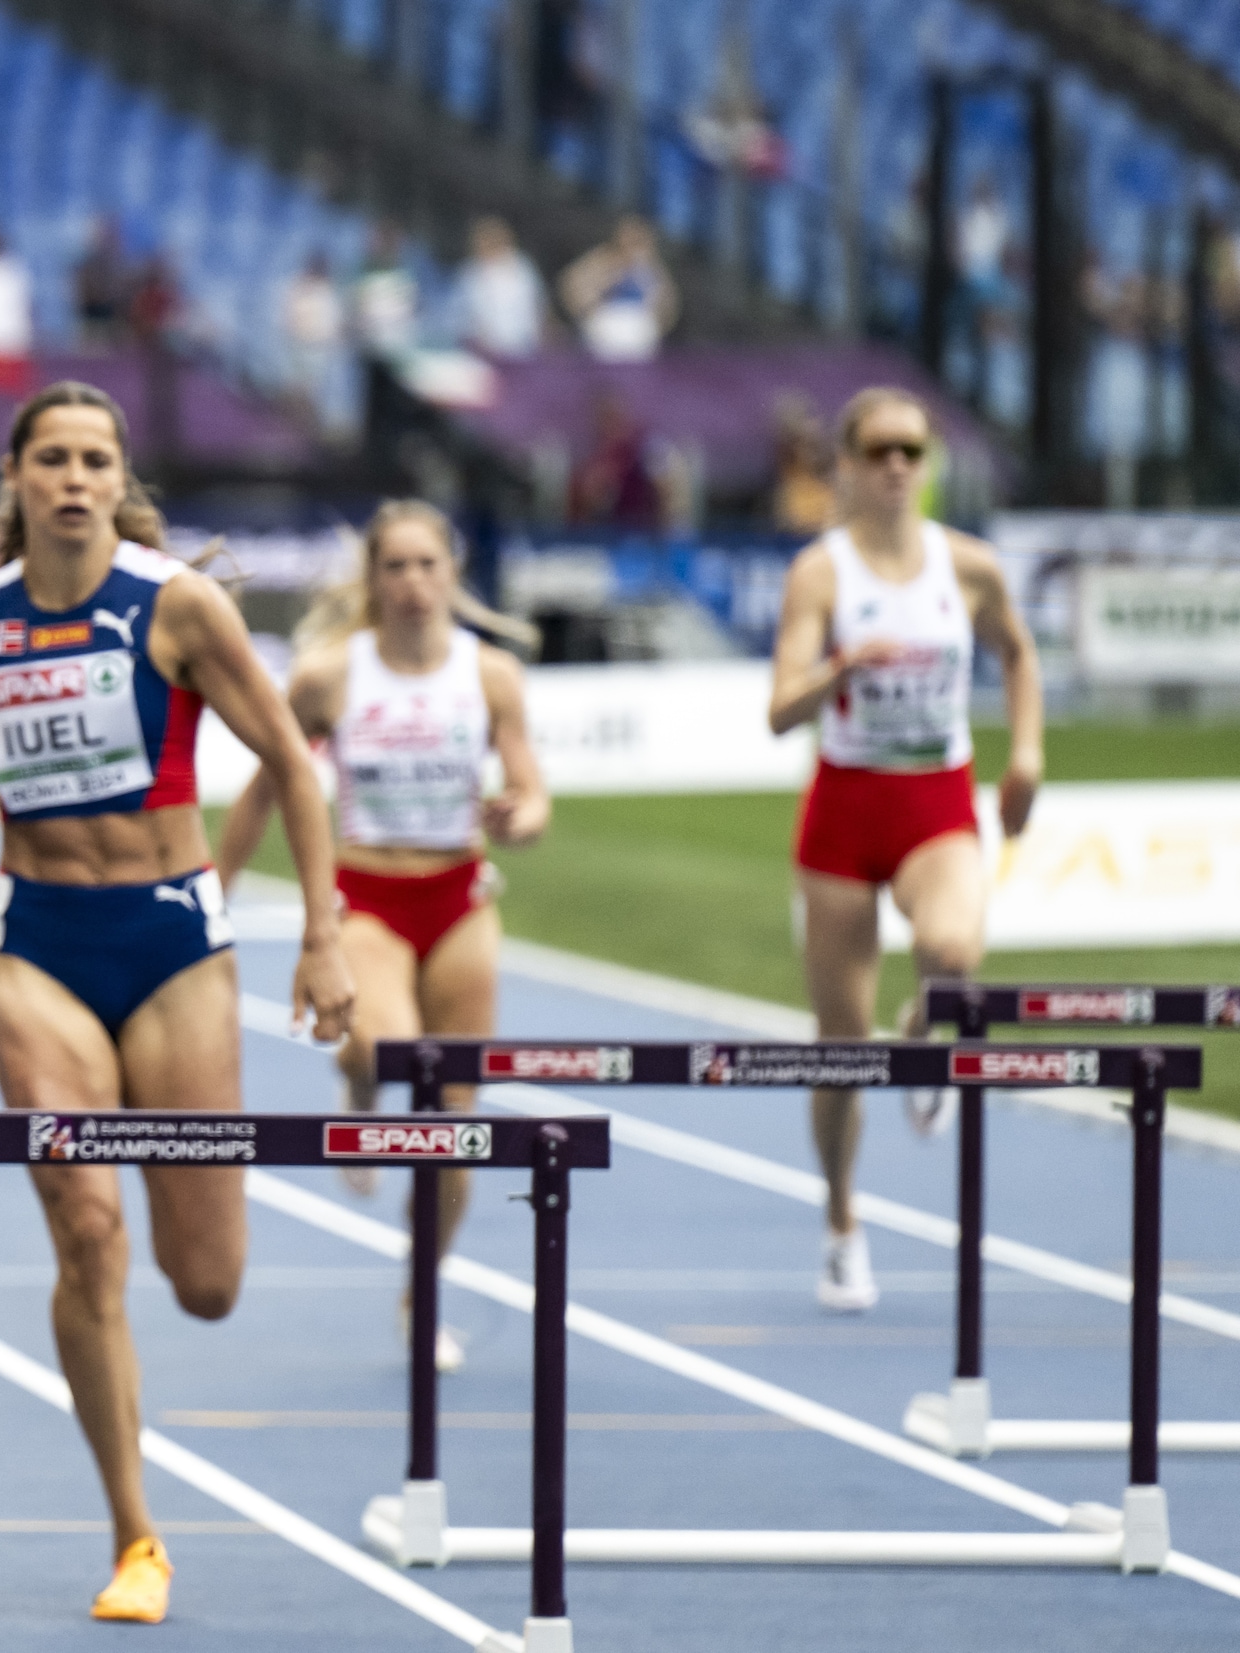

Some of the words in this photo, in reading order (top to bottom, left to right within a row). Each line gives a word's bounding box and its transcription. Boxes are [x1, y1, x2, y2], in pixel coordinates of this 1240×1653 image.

[3, 712, 106, 758] IUEL
[980, 1055, 1066, 1080] SPAR
[78, 1140, 257, 1160] CHAMPIONSHIPS
[360, 1130, 453, 1153] SPAR
